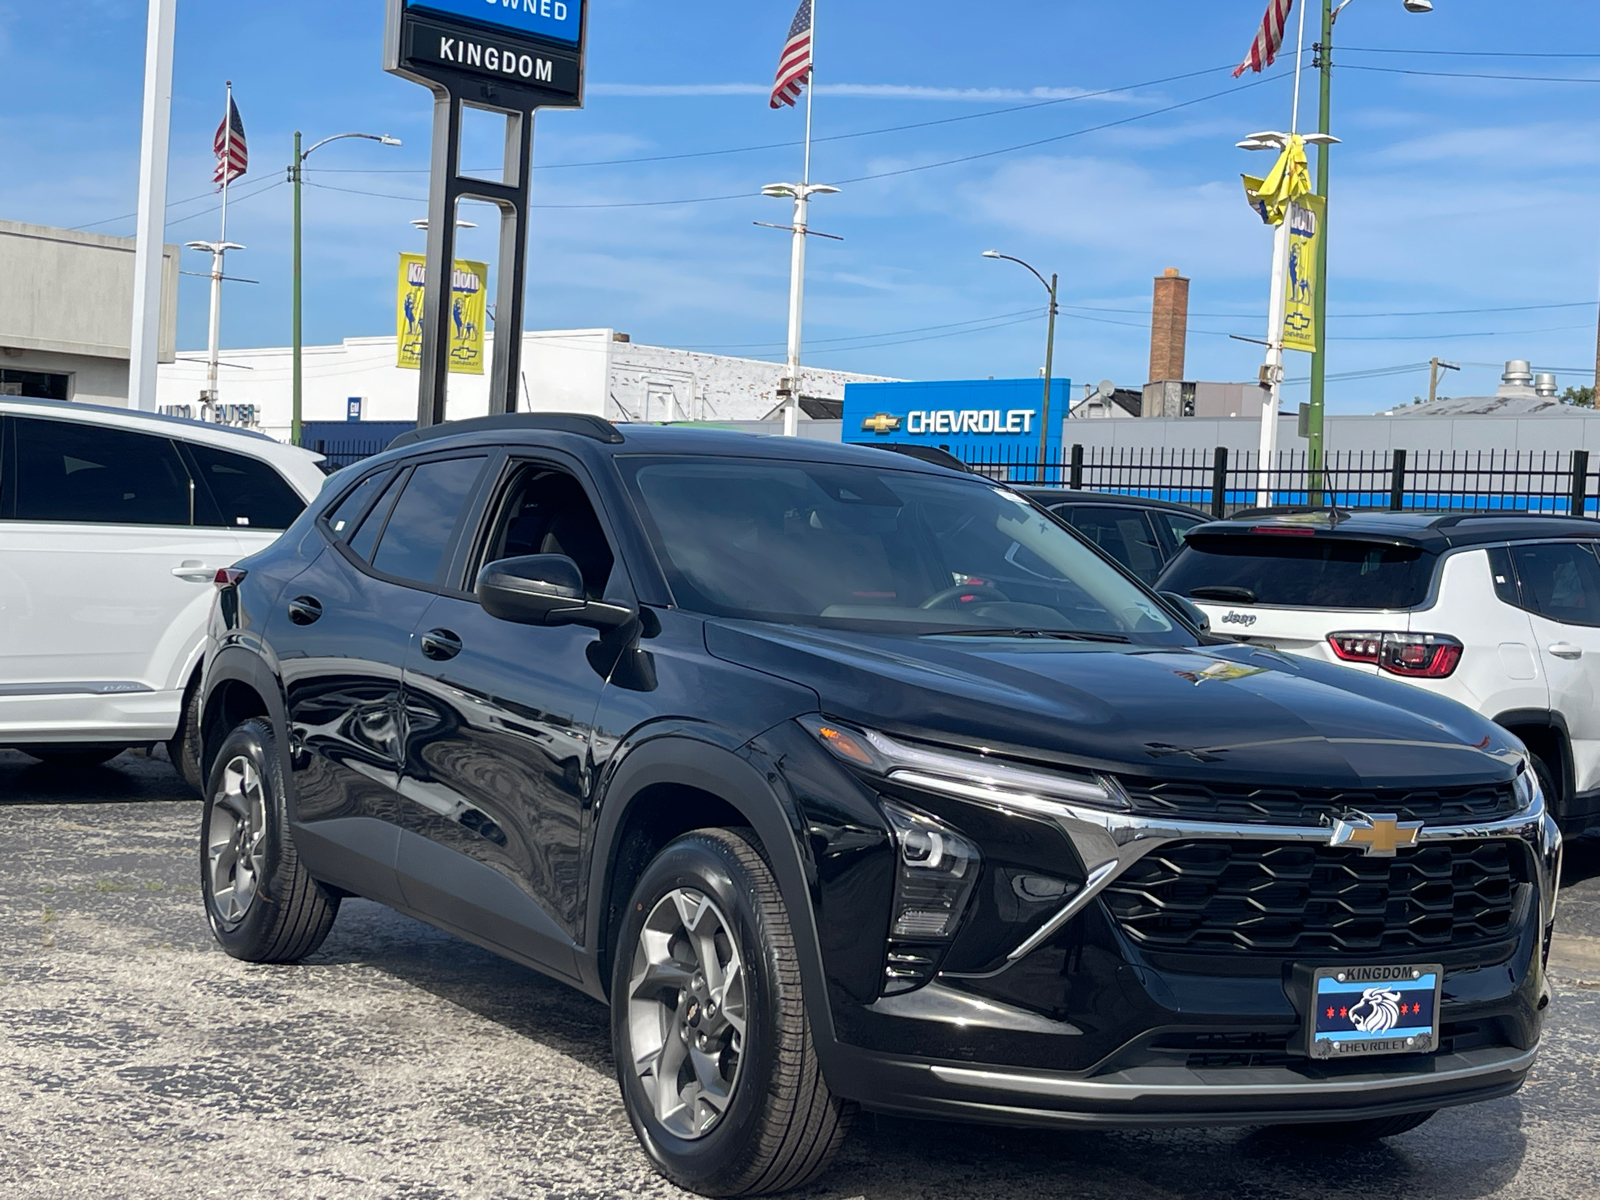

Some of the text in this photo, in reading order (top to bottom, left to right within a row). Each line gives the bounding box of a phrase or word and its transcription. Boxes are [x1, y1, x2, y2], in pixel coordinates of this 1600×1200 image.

[439, 36, 553, 82] KINGDOM
[200, 404, 256, 422] CNTER
[907, 409, 1036, 433] CHEVROLET
[1221, 610, 1257, 627] Jeep
[1346, 966, 1413, 981] KINGDOM
[1339, 1040, 1406, 1053] CHEVROLET
